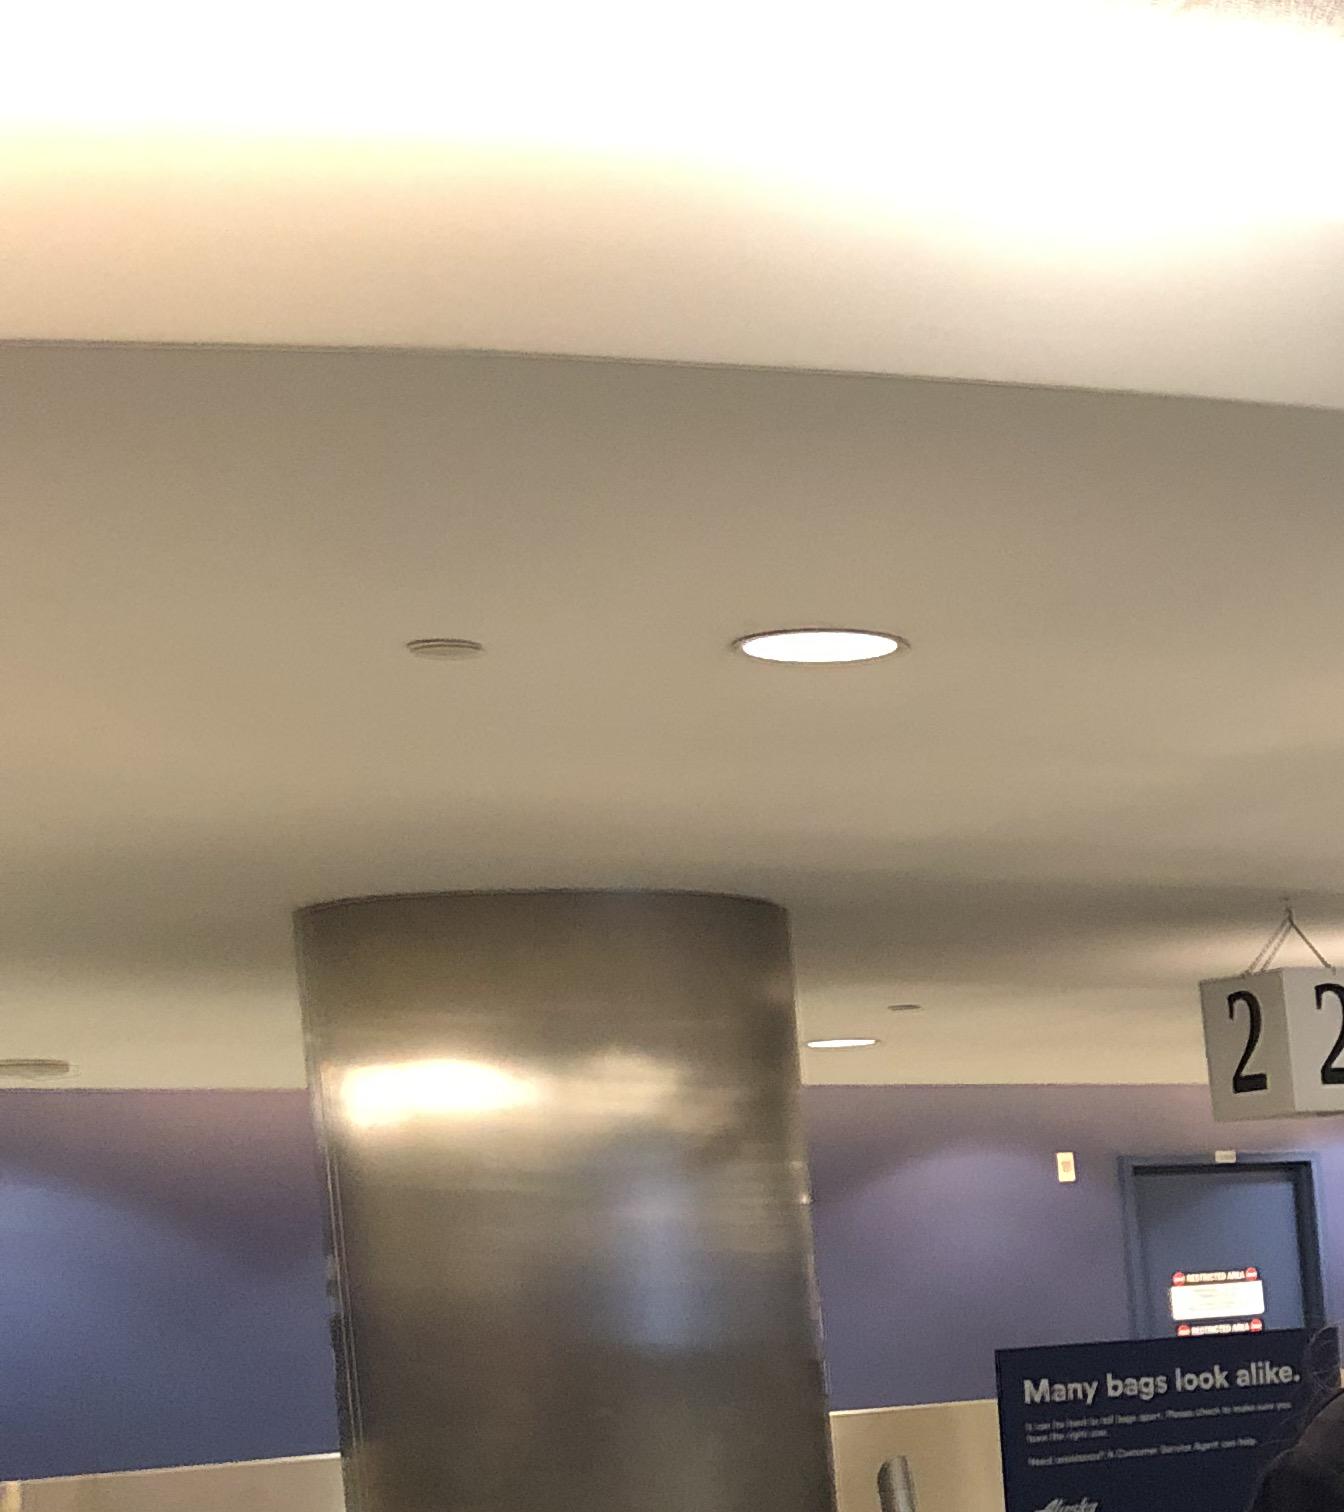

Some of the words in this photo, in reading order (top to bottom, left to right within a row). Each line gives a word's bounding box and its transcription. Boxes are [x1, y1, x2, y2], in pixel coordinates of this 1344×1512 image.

[1226, 990, 1268, 1095] 2
[1023, 1378, 1099, 1406] Many
[1106, 1373, 1169, 1401] bags
[1174, 1365, 1231, 1393] look
[1235, 1361, 1301, 1388] alike.
